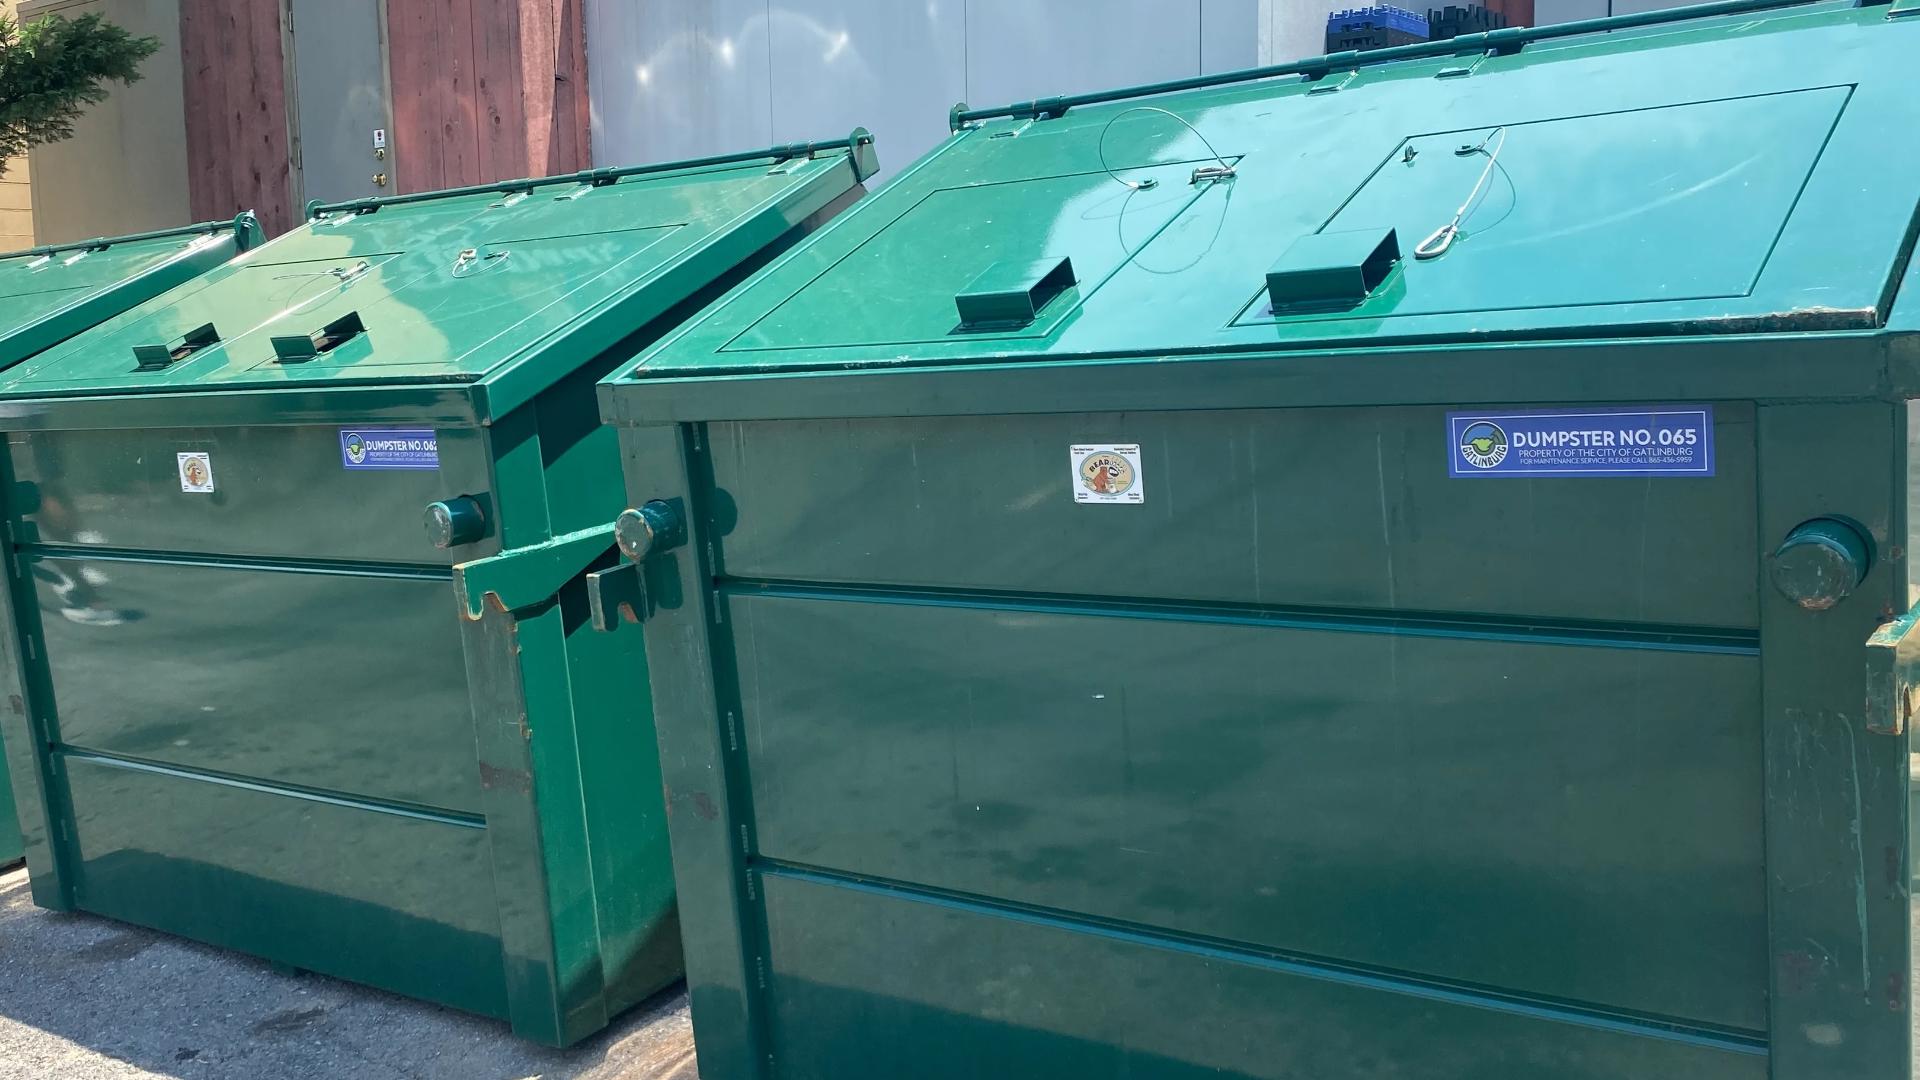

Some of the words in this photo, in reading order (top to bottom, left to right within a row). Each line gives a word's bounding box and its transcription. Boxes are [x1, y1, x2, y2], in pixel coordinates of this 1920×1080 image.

[1513, 431, 1616, 447] DUMPSTER
[1620, 429, 1656, 446] NO.
[1659, 429, 1697, 446] 065
[366, 441, 407, 451] DUMPSTER
[408, 441, 423, 451] NO.
[1462, 446, 1507, 467] GATLINBURG
[1519, 449, 1562, 457] PROPERTY
[1563, 449, 1576, 457] OF
[1577, 449, 1596, 457] THE
[1596, 448, 1617, 457] CITY
[1618, 448, 1631, 456] OF
[1633, 447, 1693, 457] GATLINBURG
[1580, 457, 1608, 465] SERVICE,
[1648, 456, 1693, 464] 865-436-5959
